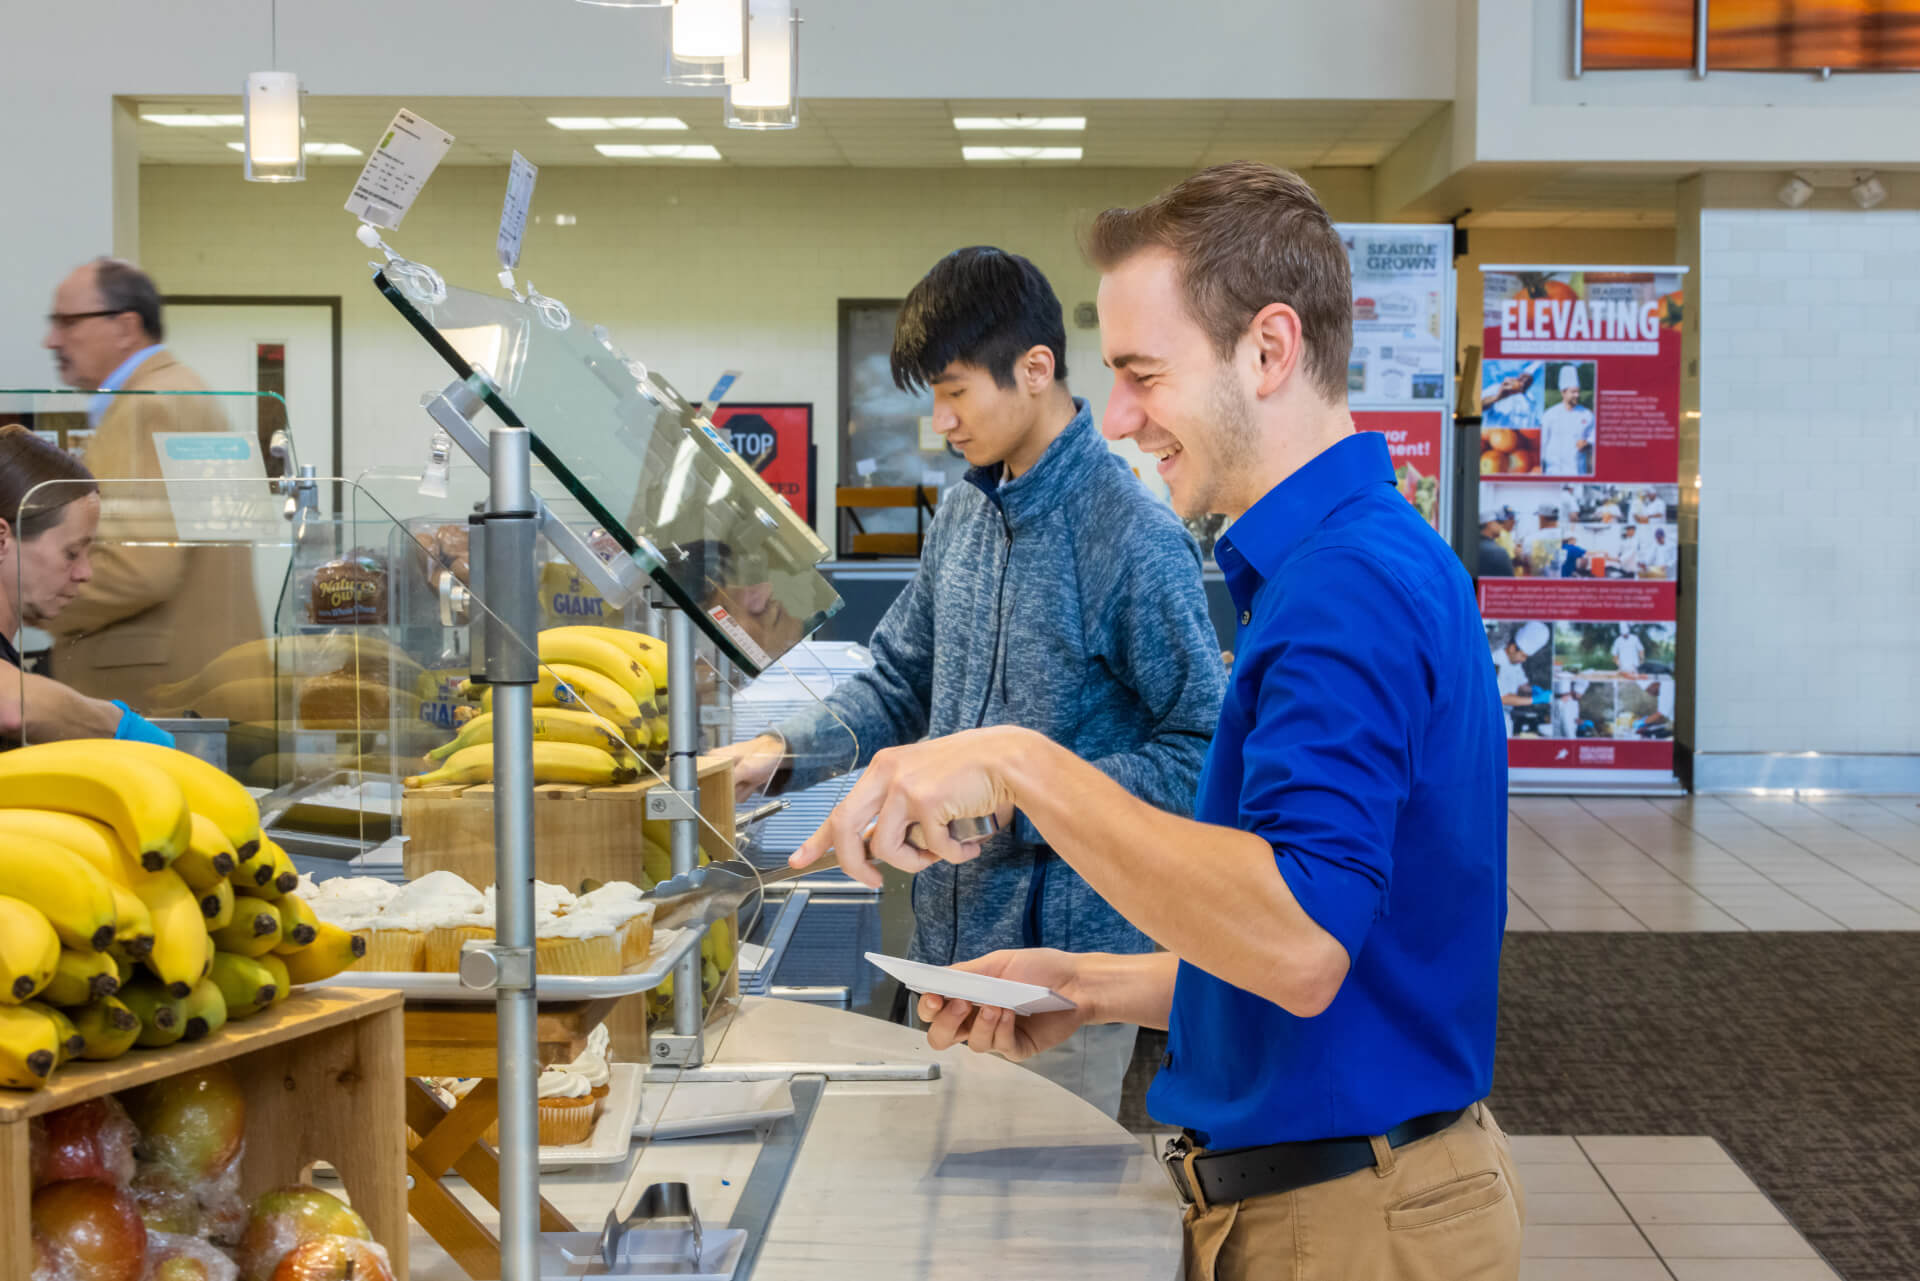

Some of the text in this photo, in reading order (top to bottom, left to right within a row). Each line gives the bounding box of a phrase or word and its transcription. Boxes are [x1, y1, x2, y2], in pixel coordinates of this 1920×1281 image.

[1366, 243, 1438, 256] SEASIDE
[1366, 256, 1437, 271] GROWN
[1500, 298, 1660, 340] ELEVATING
[553, 592, 604, 617] GIANT
